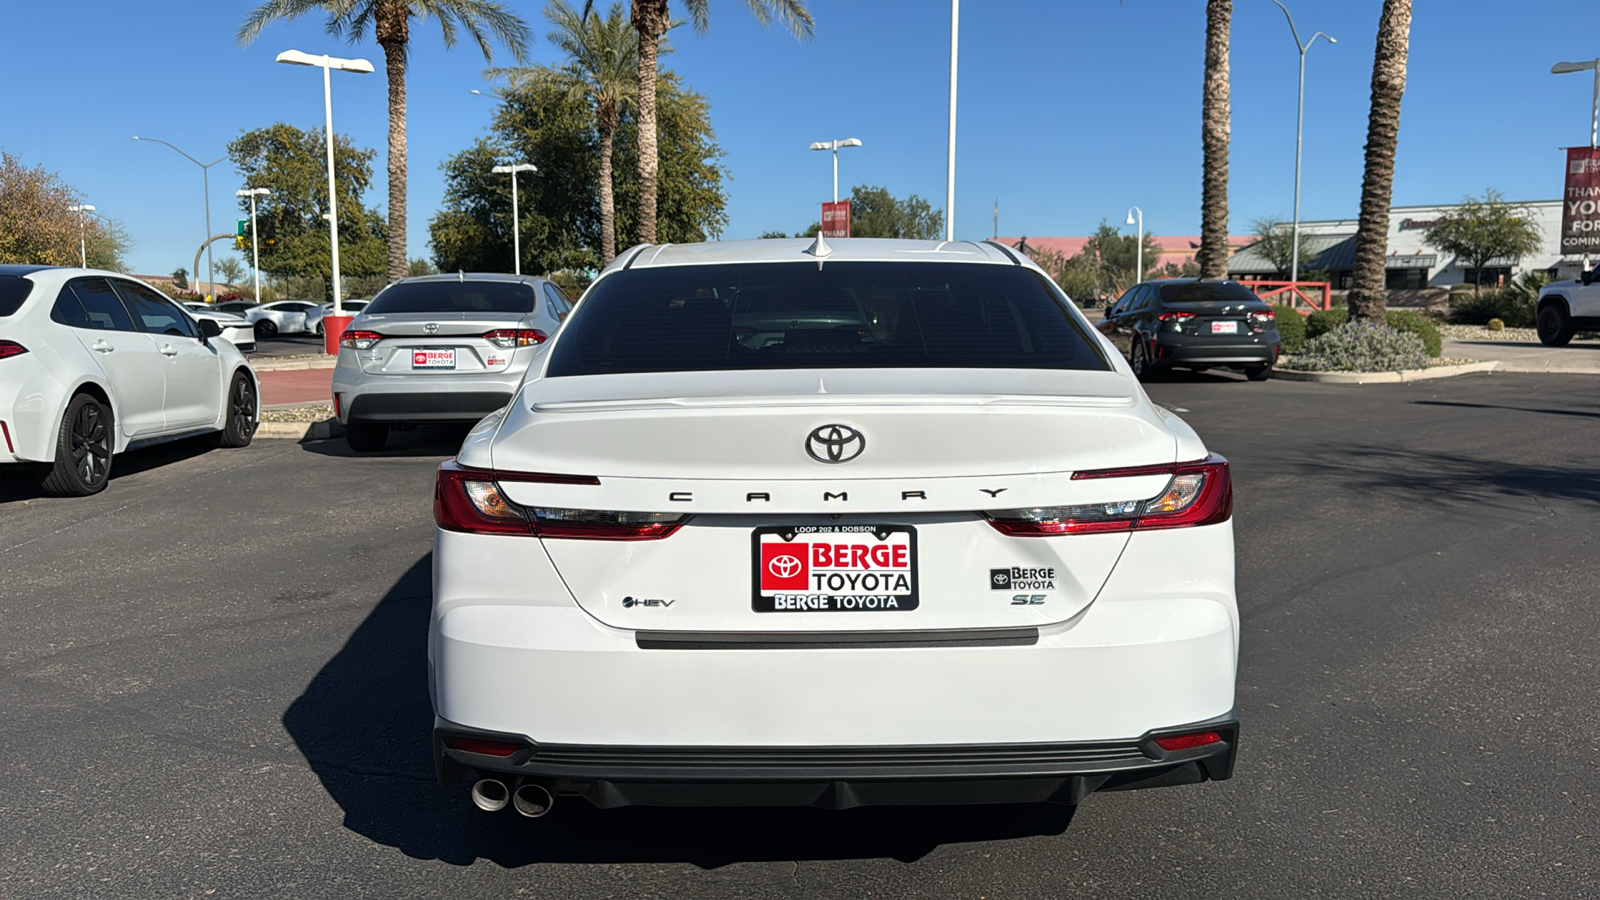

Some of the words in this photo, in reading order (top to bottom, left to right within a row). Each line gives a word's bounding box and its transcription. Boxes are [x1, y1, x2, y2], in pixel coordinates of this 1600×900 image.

[1573, 220, 1600, 232] FOR
[428, 352, 453, 360] BERGE
[669, 487, 1008, 502] CAMRY
[812, 543, 907, 570] BERGE
[1011, 567, 1055, 580] BERGE
[812, 573, 910, 591] TOYOTA
[1011, 580, 1055, 590] TOYOTA
[634, 598, 676, 608] HEV
[774, 594, 829, 611] BERGE
[834, 595, 899, 609] TOYOTA
[1010, 594, 1047, 606] SE
